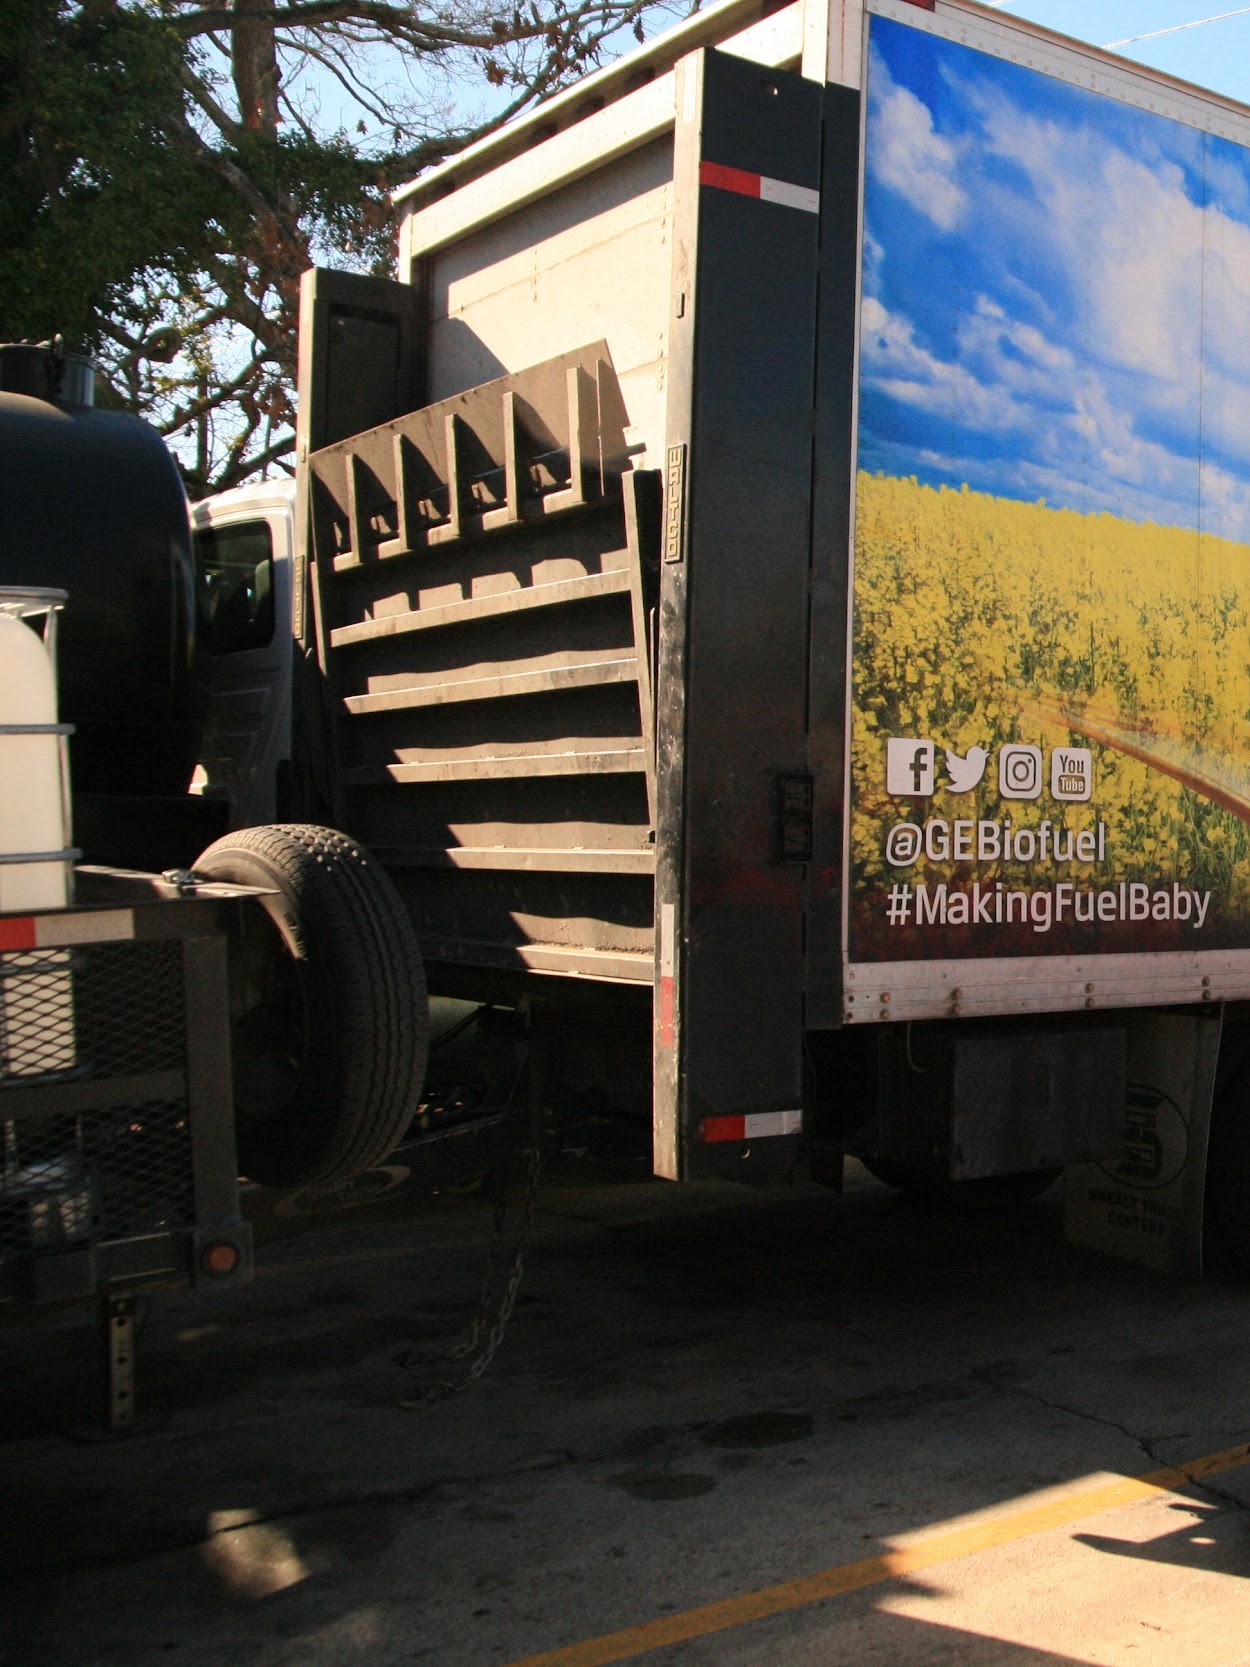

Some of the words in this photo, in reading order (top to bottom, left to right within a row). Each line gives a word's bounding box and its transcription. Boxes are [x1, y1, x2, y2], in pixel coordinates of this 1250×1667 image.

[667, 448, 682, 558] WALTCO
[1058, 775, 1086, 794] Tube
[1060, 755, 1085, 775] You
[886, 818, 1106, 866] @GEBiofuel
[886, 882, 1211, 932] #MakingFuelBaby
